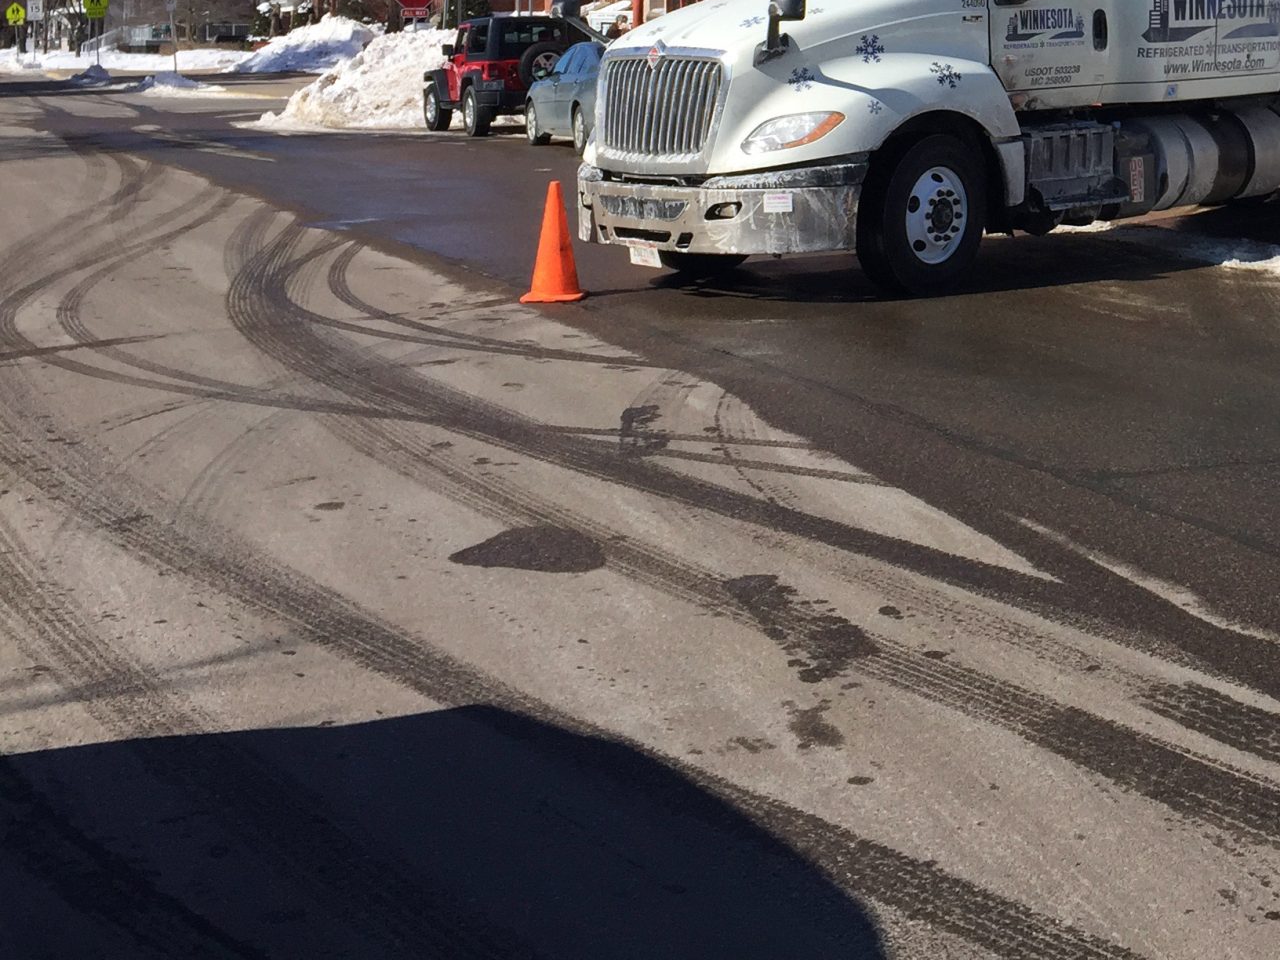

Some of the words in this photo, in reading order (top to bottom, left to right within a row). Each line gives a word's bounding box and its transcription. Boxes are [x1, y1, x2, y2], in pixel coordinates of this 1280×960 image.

[30, 5, 40, 13] 15
[1020, 8, 1074, 30] WINNESOTA
[1137, 45, 1205, 58] REFRIGERATED
[1025, 66, 1053, 77] USDOT
[1163, 57, 1265, 74] www.Winnesota.com
[1031, 77, 1043, 85] MC
